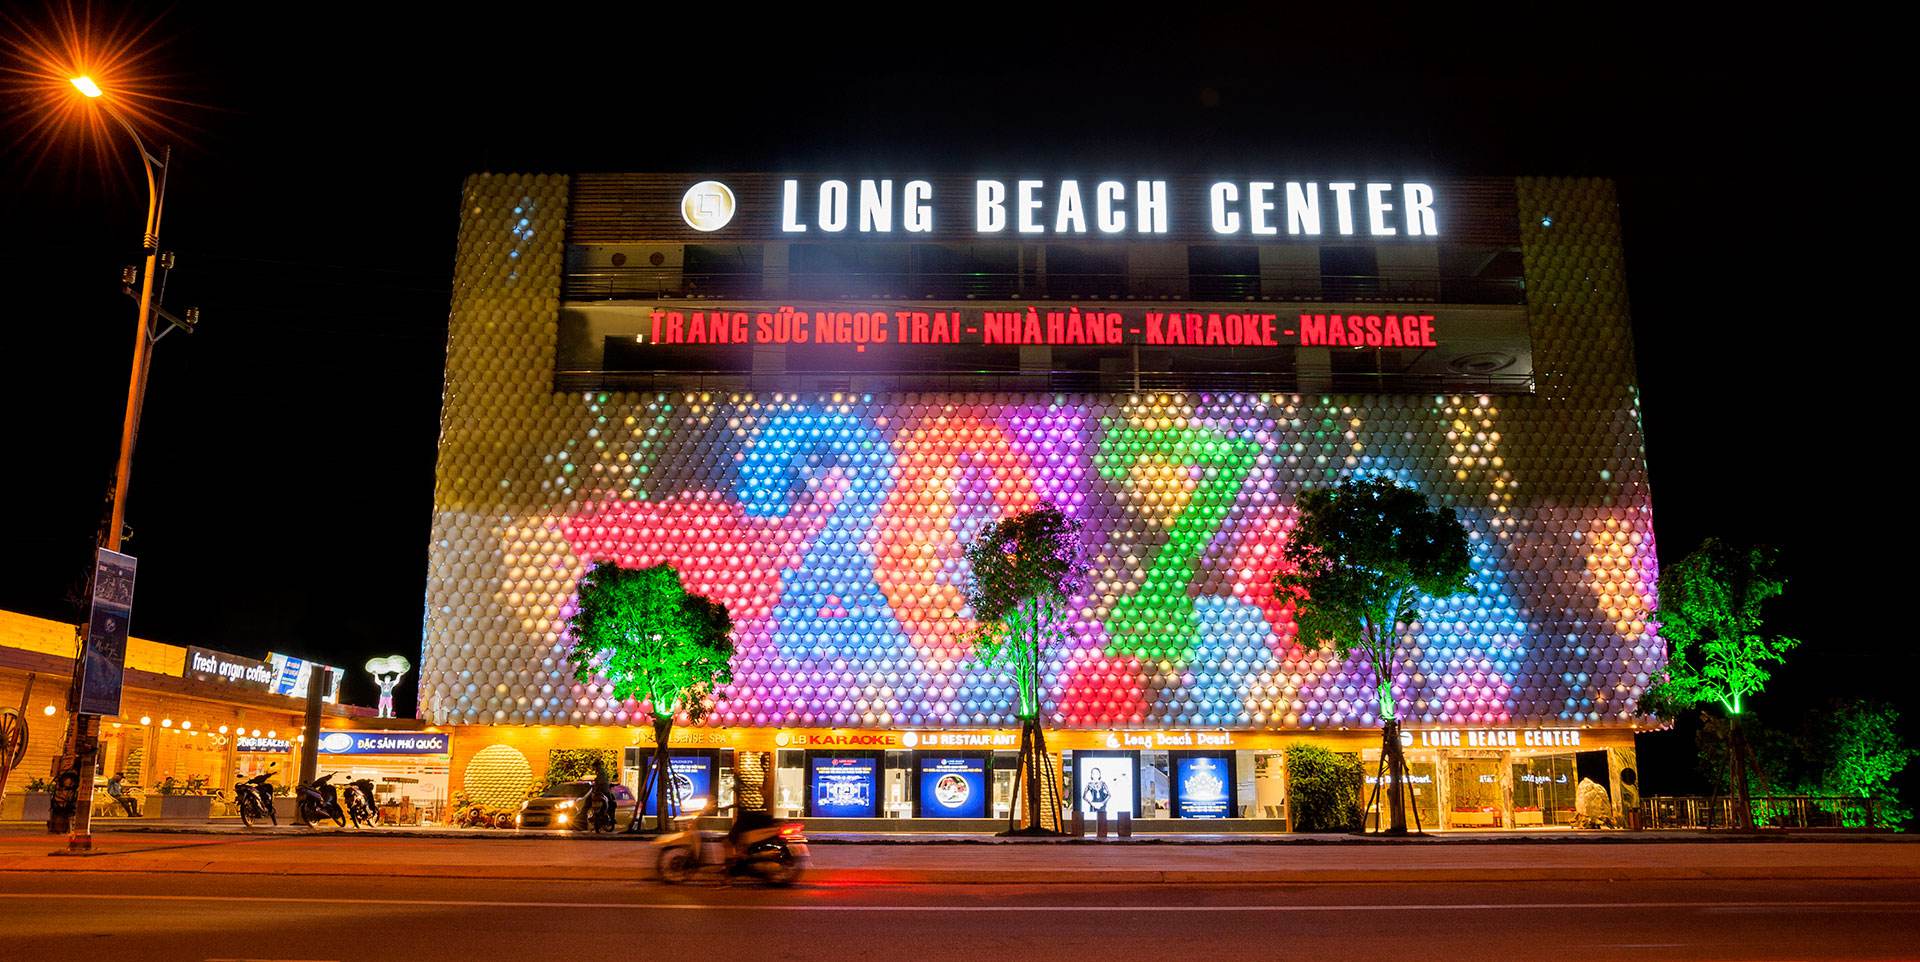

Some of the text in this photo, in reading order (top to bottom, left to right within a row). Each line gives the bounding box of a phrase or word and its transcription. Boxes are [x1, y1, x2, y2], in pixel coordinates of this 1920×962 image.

[782, 179, 1438, 236] LONG BEACH CENTER
[649, 310, 749, 345] TRANG
[755, 306, 809, 345] SỨC
[814, 311, 889, 352] NGỌC
[895, 311, 961, 345] TRAI
[983, 306, 1044, 345] NHÀ
[1046, 306, 1123, 345] HÀNG
[1145, 312, 1279, 346] KARAOKE
[1299, 314, 1438, 348] MASSAGE
[193, 652, 218, 674] fresh
[218, 661, 245, 682] origin
[245, 665, 272, 684] coffee
[357, 738, 377, 750] ĐẶC
[397, 737, 416, 749] PHÚ
[415, 736, 443, 750] QUỐC
[792, 735, 896, 745] LB KARAOKE
[921, 734, 1017, 746] LB RESTAURANT
[1124, 733, 1152, 748] Long
[1157, 733, 1192, 746] Beach
[1421, 731, 1580, 747] LONG BEACH CENTER
